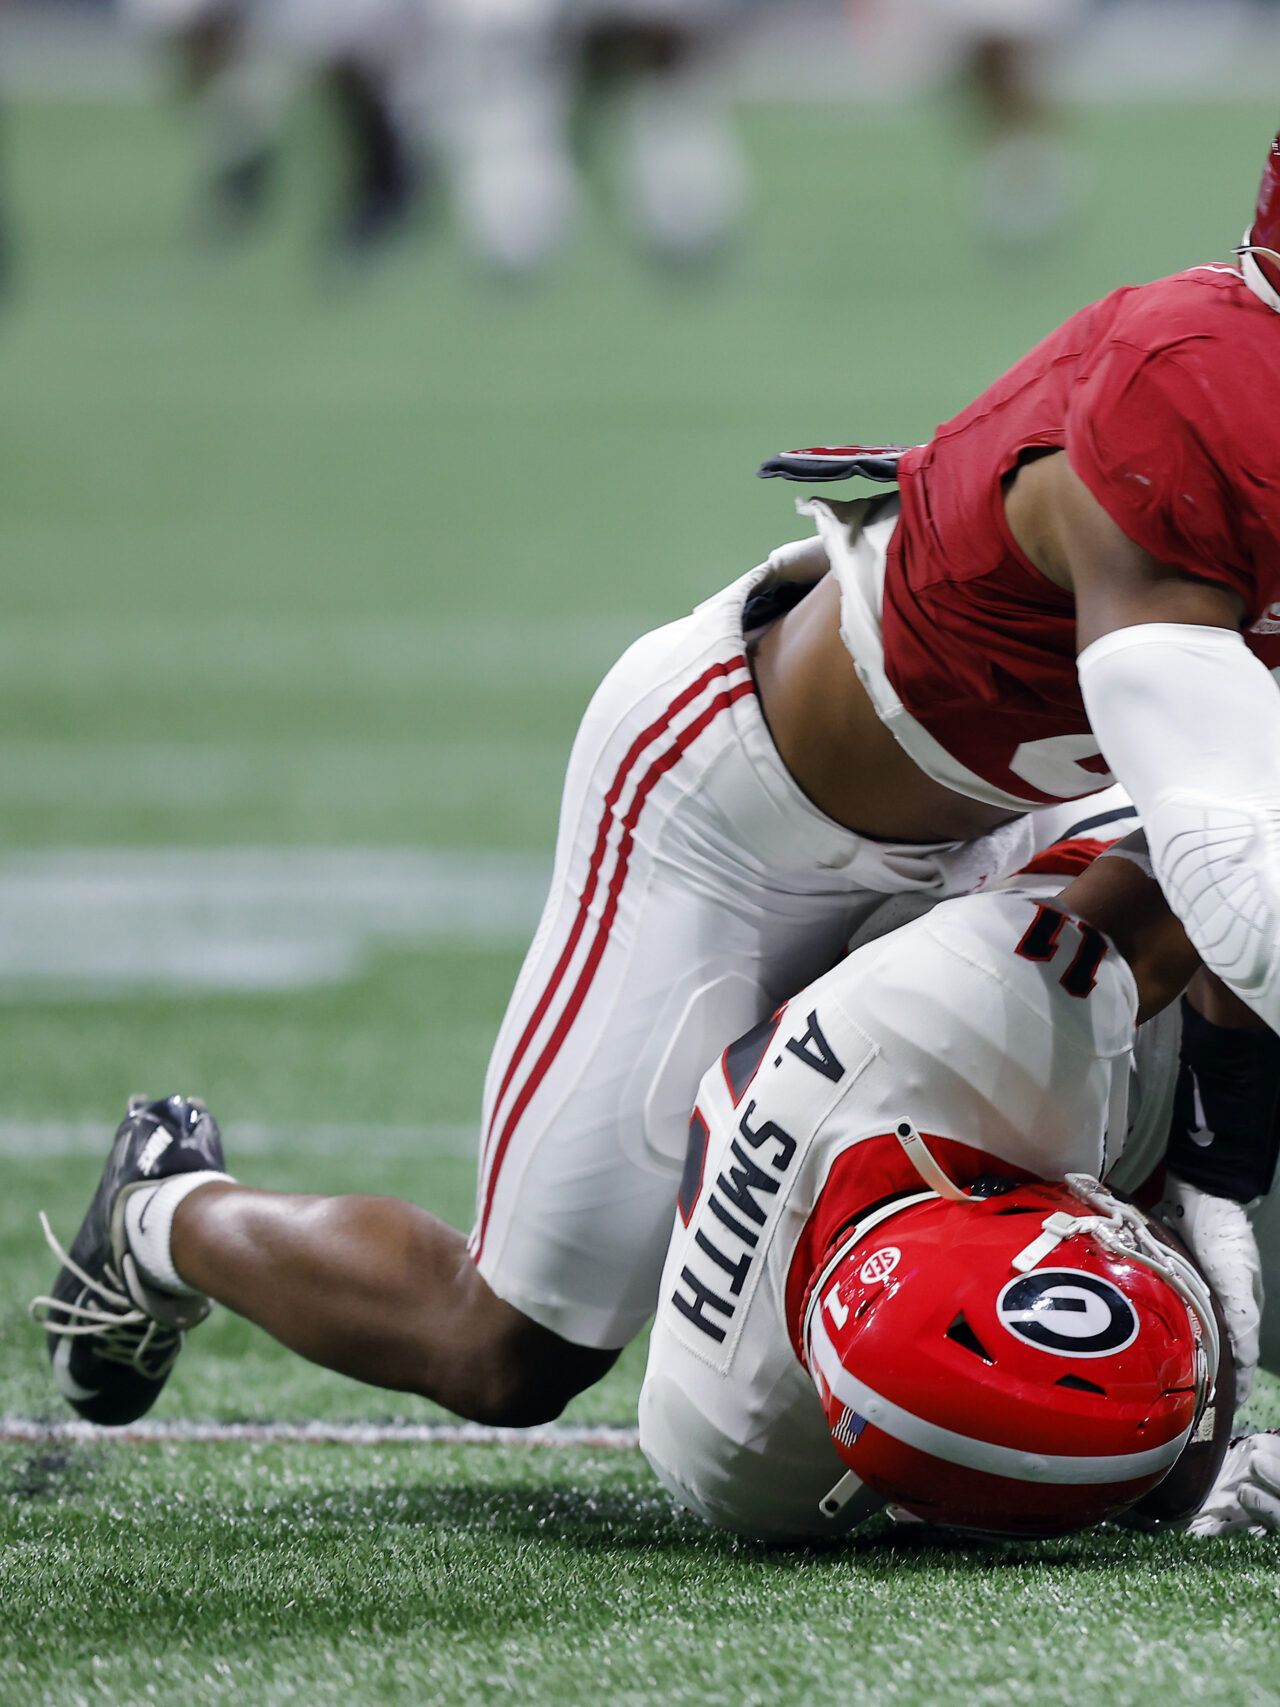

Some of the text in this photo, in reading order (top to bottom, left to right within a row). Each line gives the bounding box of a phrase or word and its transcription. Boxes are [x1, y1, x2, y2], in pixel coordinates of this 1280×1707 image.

[773, 1008, 847, 1084] A.
[671, 1098, 798, 1345] SMITH
[863, 1249, 898, 1281] SEC
[1001, 1271, 1136, 1353] G
